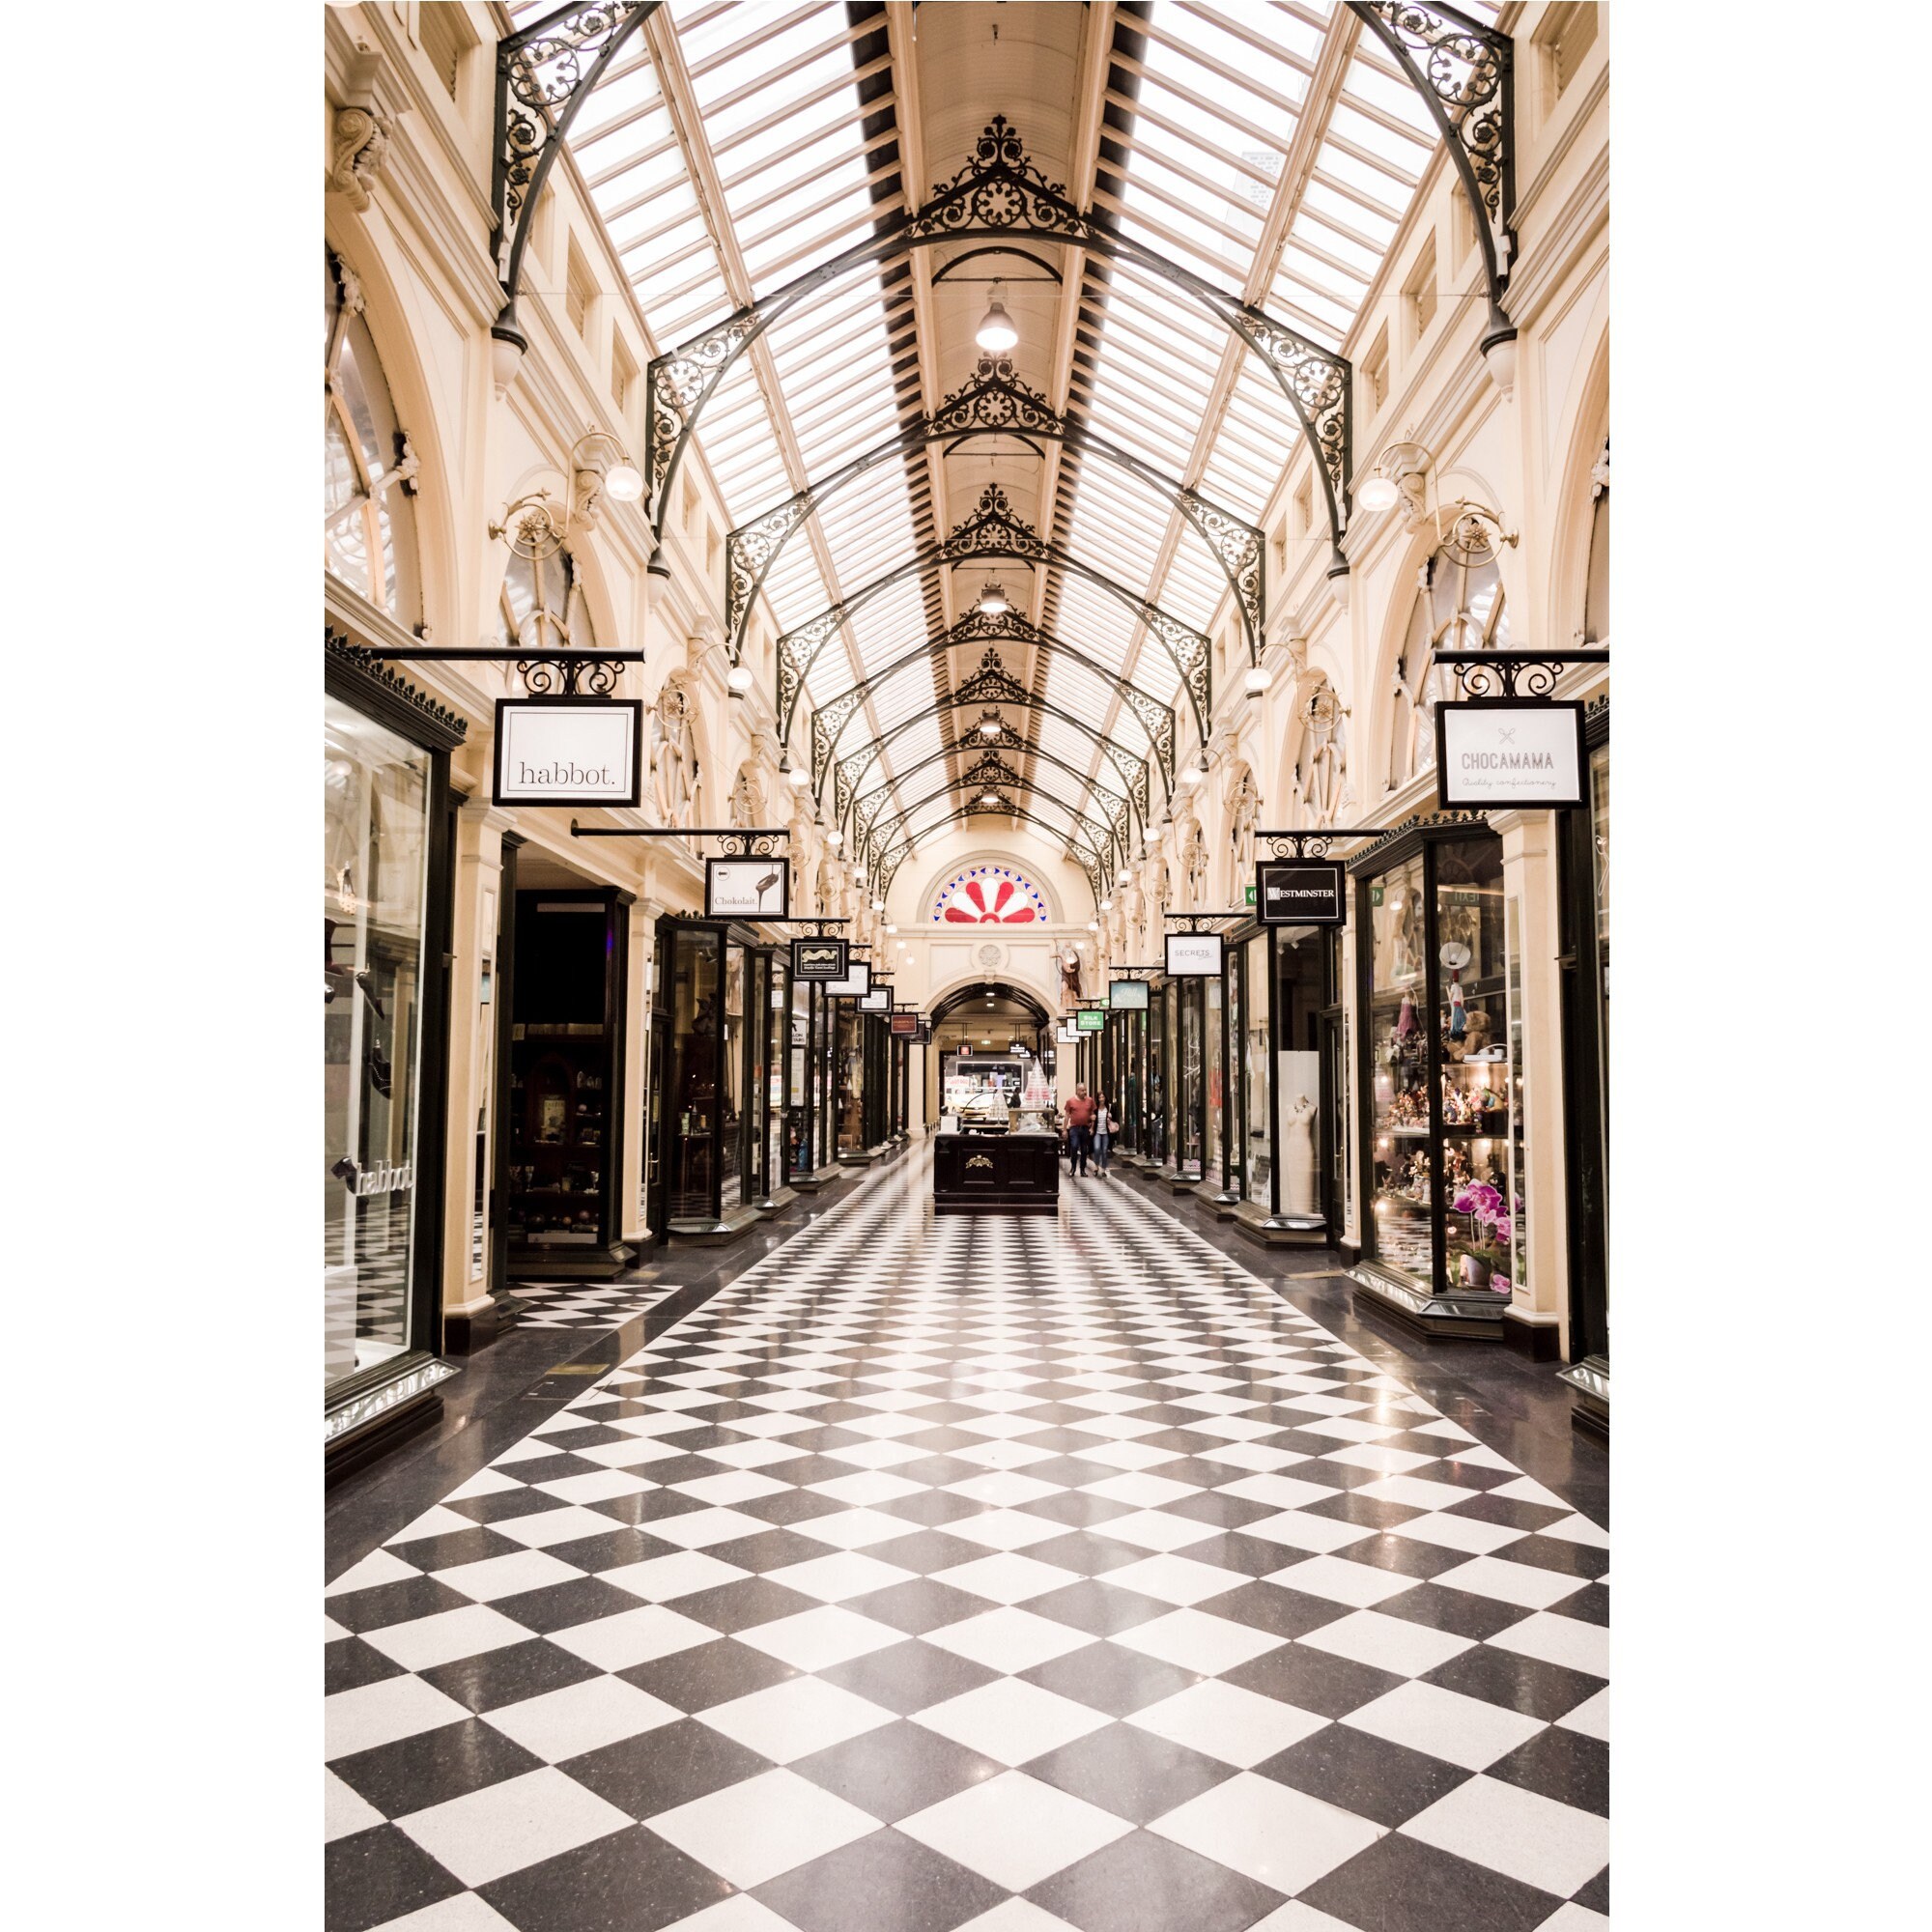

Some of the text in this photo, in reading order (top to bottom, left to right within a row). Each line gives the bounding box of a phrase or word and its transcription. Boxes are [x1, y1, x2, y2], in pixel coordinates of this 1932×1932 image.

[1461, 752, 1554, 770] CHOCAMAMA
[518, 761, 615, 785] habbot.
[1462, 777, 1557, 789] Quality confectionery
[1267, 887, 1335, 900] WESTMINSTER
[714, 895, 758, 906] Chokolait.
[1174, 949, 1210, 957] SECRETS
[355, 1159, 414, 1197] habbot
